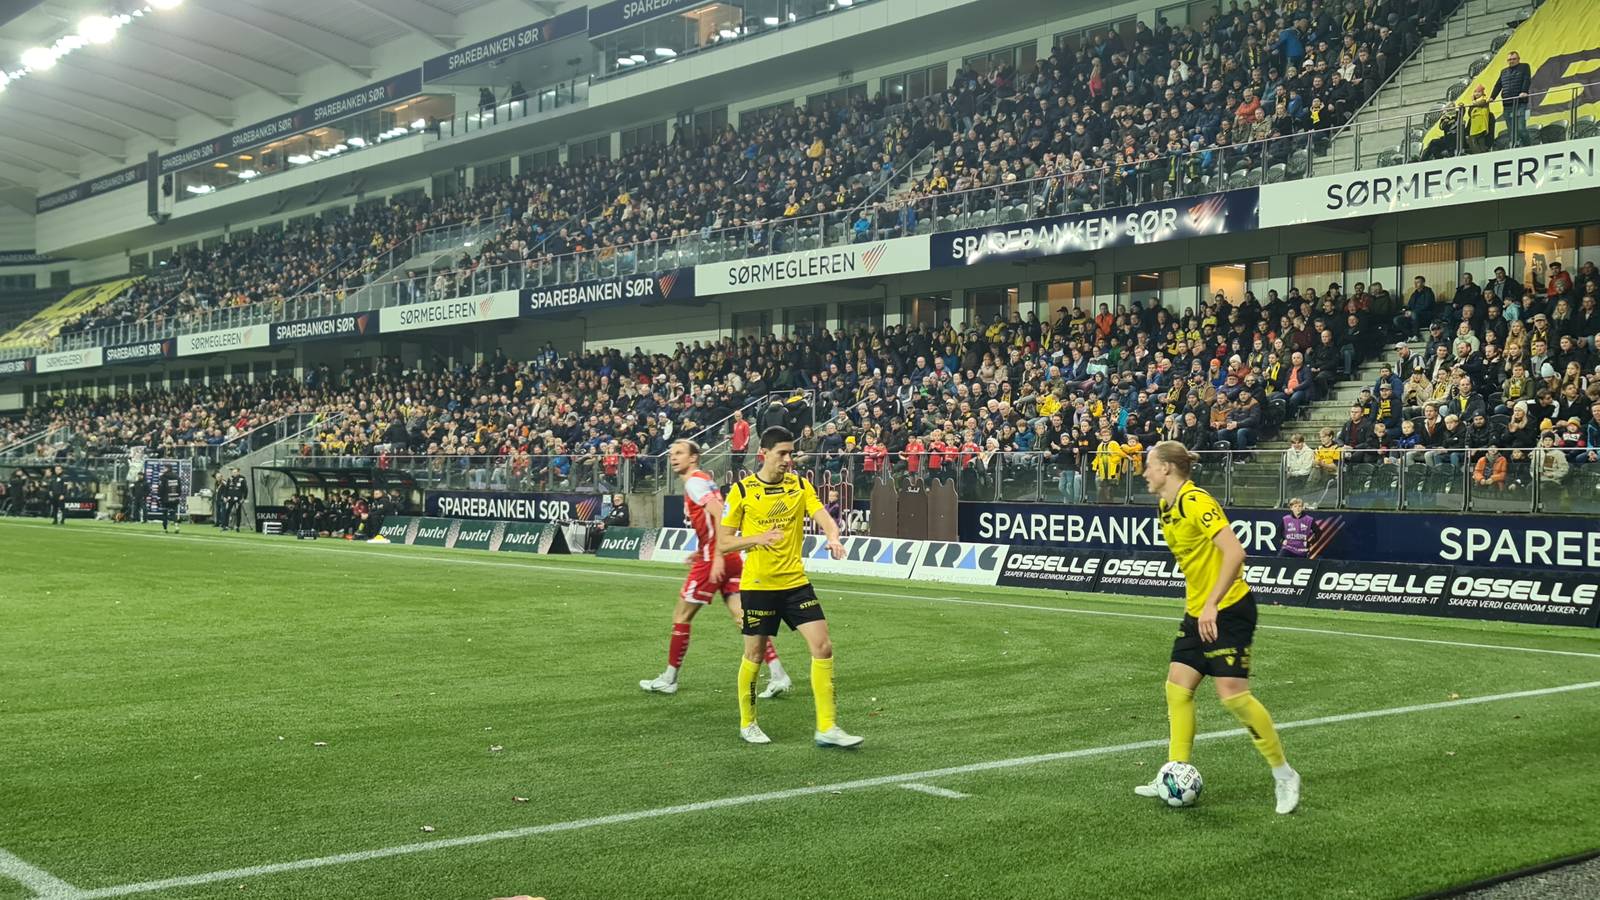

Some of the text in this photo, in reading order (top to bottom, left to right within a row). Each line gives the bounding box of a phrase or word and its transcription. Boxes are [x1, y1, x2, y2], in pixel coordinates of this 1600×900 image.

[449, 28, 539, 70] SPAREBANKEN SØR
[314, 87, 385, 120] SPAREBANKEN SØR
[1326, 148, 1594, 210] SØRMEGLEREN
[952, 207, 1178, 260] SPAREBANKEN SØR
[729, 252, 855, 286] SØRMEGLEREN
[531, 277, 654, 309] SPAREBANKEN SØR
[400, 302, 476, 326] SØRMEGLEREN
[277, 317, 355, 340] SPAREBANKEN SØR
[191, 332, 242, 350] SØRMEGLEREN
[438, 496, 571, 521] SPAREBANKEN SØR
[380, 524, 408, 537] nortel
[418, 527, 448, 539] nortel
[459, 529, 491, 542] nortel
[505, 532, 539, 546] nortel
[1230, 519, 1277, 551] ØR
[601, 535, 640, 551] nortel
[847, 537, 915, 565] KRAG
[922, 543, 1000, 570] KRAG
[1007, 553, 1100, 574] OSSELLE
[1004, 570, 1022, 578] SKAPER
[1103, 558, 1186, 579] OSSELL
[1100, 576, 1121, 584] SKAPER
[1319, 572, 1447, 594] OSSELLE
[1451, 576, 1598, 605] OSSELLE
[1316, 592, 1342, 600] SKAPER
[1343, 593, 1364, 601] VERDI
[1364, 594, 1401, 603] GJENNOM
[1429, 596, 1439, 605] IT
[1448, 597, 1478, 607] SKAPER
[1479, 600, 1502, 609] VERDI
[1503, 602, 1546, 613] GJENNOM
[1579, 607, 1589, 616] IT
